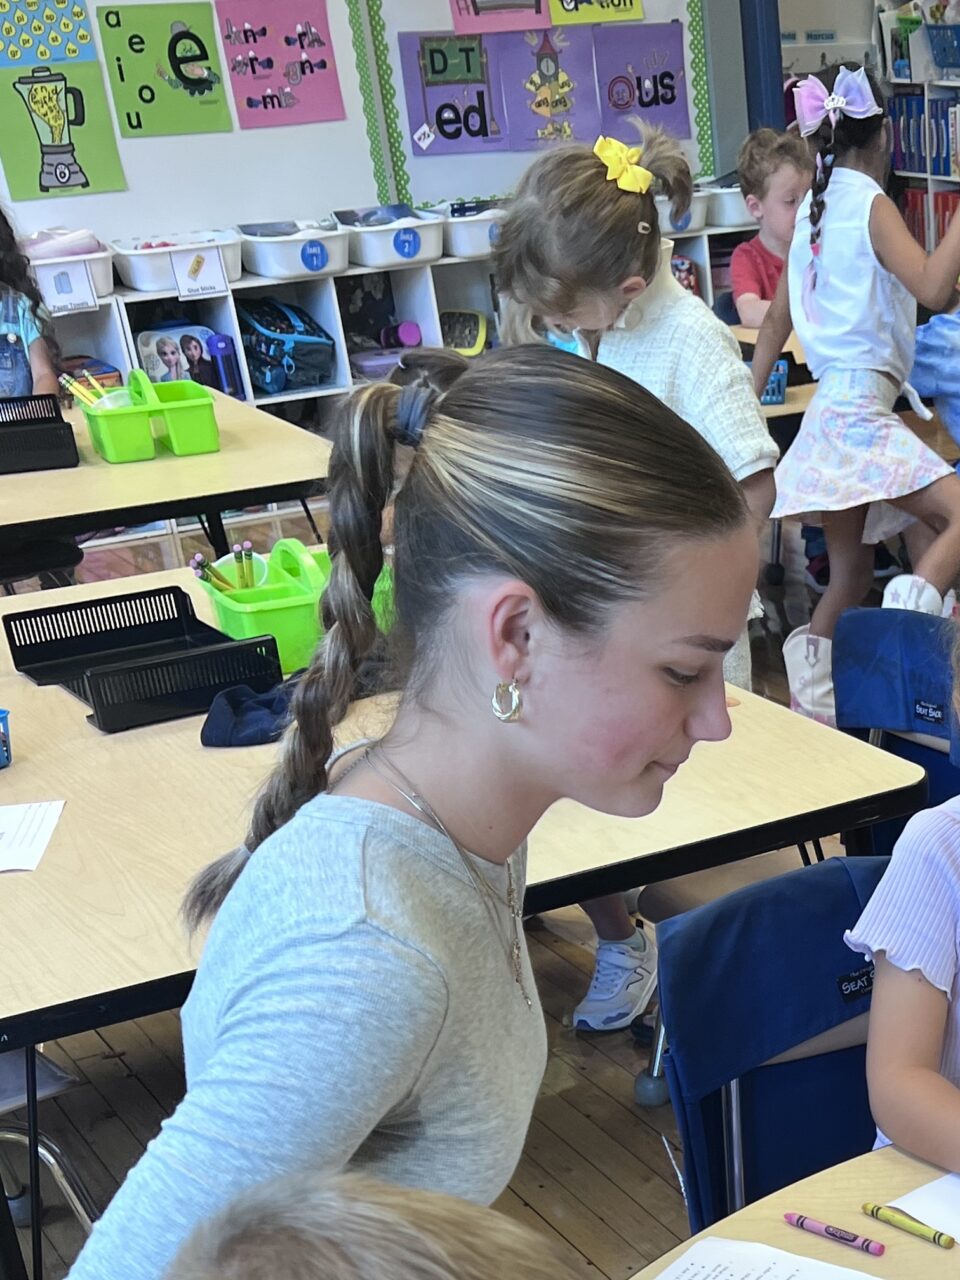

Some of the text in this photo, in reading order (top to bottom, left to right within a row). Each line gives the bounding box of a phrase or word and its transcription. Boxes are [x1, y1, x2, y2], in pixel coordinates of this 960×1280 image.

[105, 10, 122, 28] a
[127, 33, 146, 53] e
[115, 56, 126, 83] i
[138, 84, 156, 104] o
[126, 110, 143, 130] u
[435, 90, 489, 140] ed
[841, 975, 868, 995] SEAT
